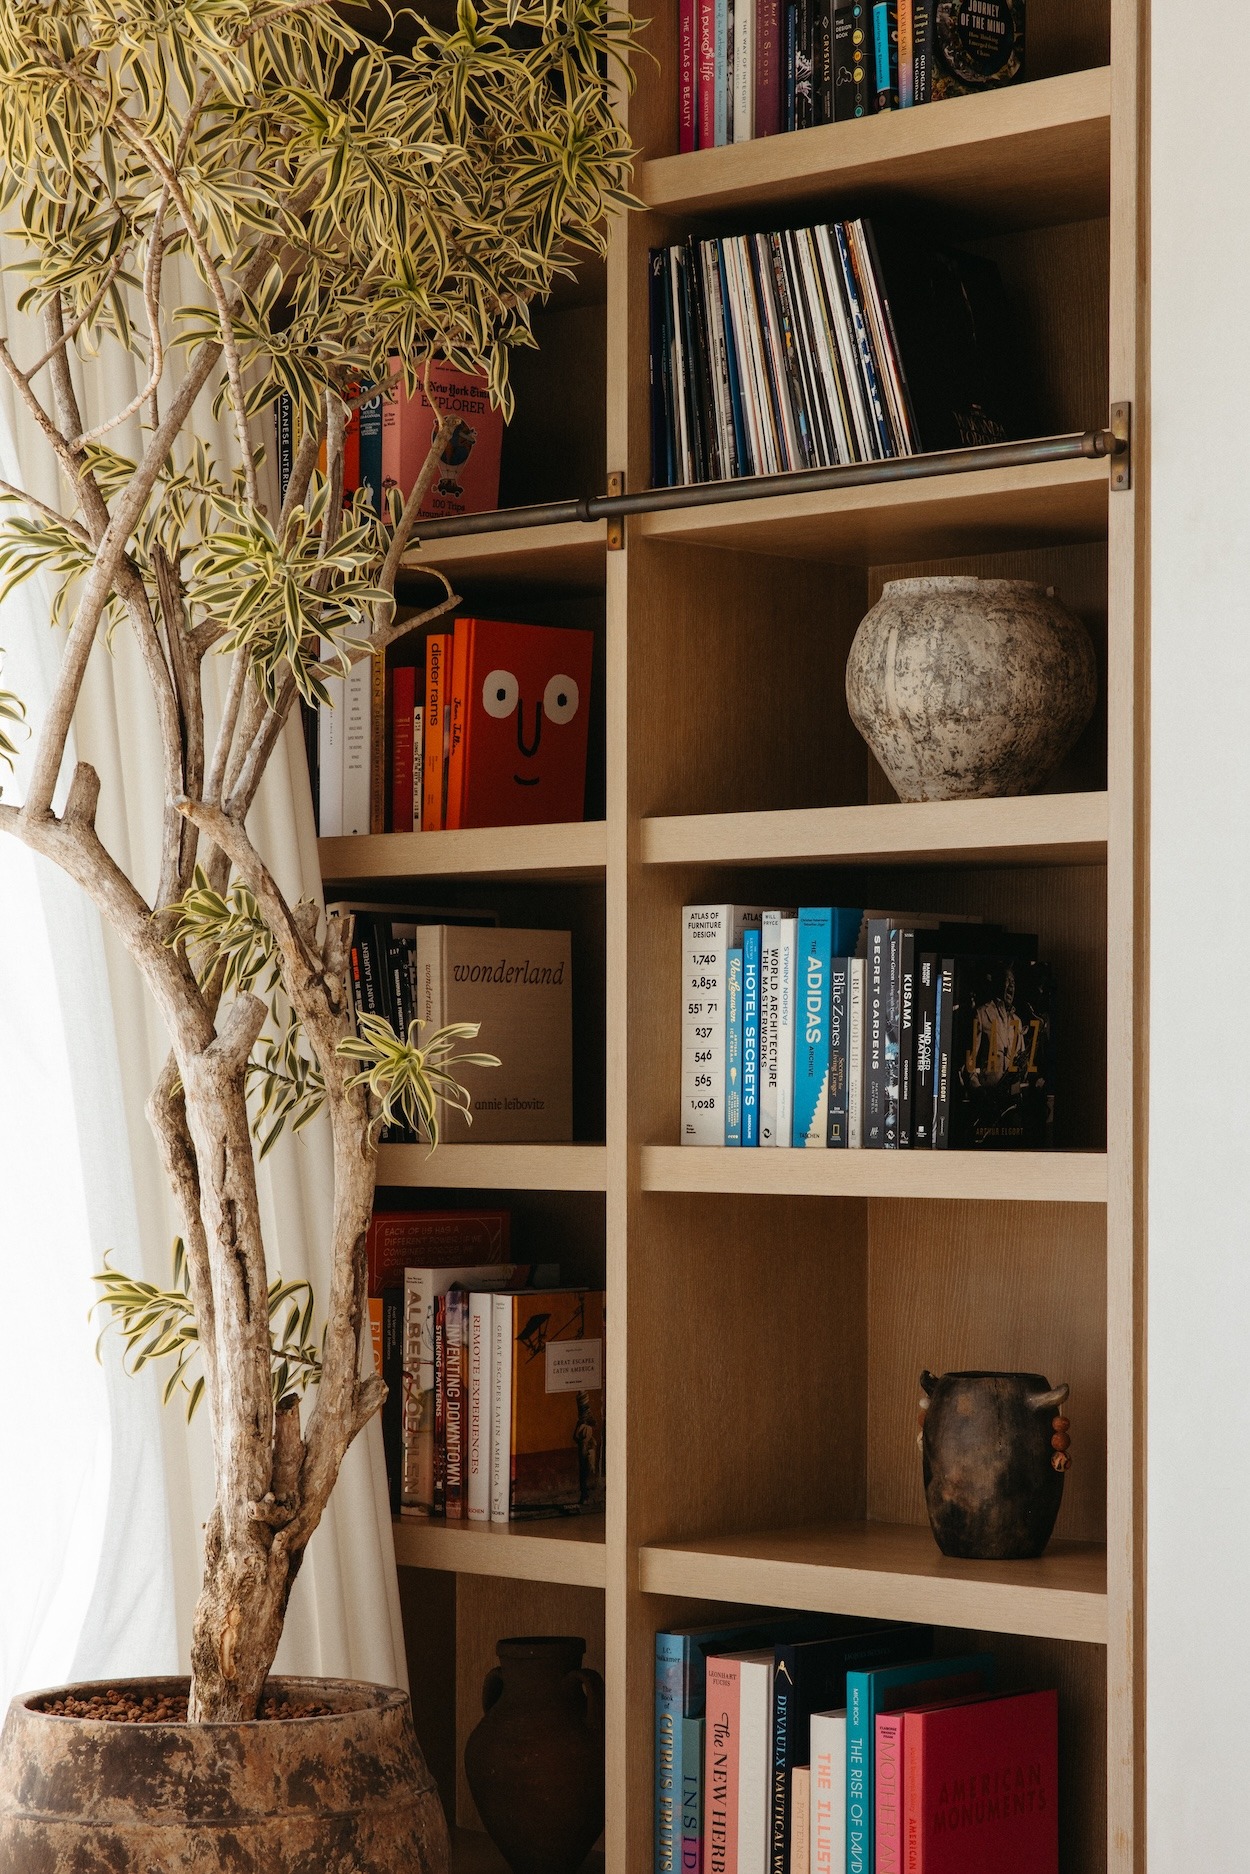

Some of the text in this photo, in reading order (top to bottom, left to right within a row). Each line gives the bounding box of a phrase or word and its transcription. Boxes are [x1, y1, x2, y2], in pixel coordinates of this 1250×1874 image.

[961, 13, 1005, 35] OF THE MIND
[968, 0, 999, 18] JOURNEY
[700, 5, 713, 81] A pukka life
[683, 71, 690, 82] OF
[742, 58, 747, 68] OF
[763, 41, 771, 86] STONE
[449, 384, 469, 397] York
[432, 499, 465, 512] 100 Trips
[430, 643, 441, 726] dieter rams
[451, 697, 461, 756] Jean Jullien
[688, 922, 721, 930] FURNITURE
[693, 931, 716, 939] DESIGN
[361, 941, 376, 1009] SAINT LAURENT
[454, 960, 565, 985] wonderland
[692, 954, 717, 965] 1,740
[425, 964, 434, 1022] wonderland
[691, 978, 717, 989] 2,852
[805, 955, 822, 1043] ADIDAS
[942, 971, 951, 993] JAZZ
[688, 1003, 717, 1014] 551 71
[769, 948, 778, 1088] WORLD ARCHITECTURE
[831, 971, 844, 1046] Blue Zones
[872, 935, 881, 1069] SECRET GARDENS
[902, 974, 912, 1029] KUSAMA
[695, 1028, 713, 1038] 237
[744, 964, 755, 1106] HOTEL SECRETS
[851, 1010, 859, 1040] GOOD
[694, 1050, 712, 1062] 546
[830, 1050, 838, 1071] Living
[923, 1046, 931, 1071] OVER
[965, 1019, 1041, 1072] JAZZ
[694, 1074, 712, 1086] 565
[830, 1073, 838, 1097] Longer
[475, 1098, 545, 1110] annie leibovitz
[691, 1098, 715, 1109] 1,028
[976, 1127, 999, 1136] ARTHUR
[384, 1226, 450, 1236] EACH OF US HAS
[384, 1237, 426, 1246] DIFFERENT
[405, 1289, 422, 1387] ALBERT
[446, 1324, 461, 1486] INVENTING DOWNTOWN
[471, 1314, 480, 1475] REMOTE EXPERIENCES
[404, 1400, 422, 1495] OEHLEN
[708, 1671, 737, 1680] LEONHART
[712, 1679, 731, 1687] FUCHS
[774, 1694, 787, 1851] DEVAULX NAUTICAL
[939, 1763, 1041, 1807] AMERICAN
[659, 1713, 674, 1872] CITRUS FRUITS
[710, 1712, 730, 1874] The NEW HERB
[850, 1738, 862, 1874] THE RISE OF DAVID
[879, 1741, 896, 1874] MOTHER AN
[683, 1775, 698, 1870] INSID
[817, 1753, 831, 1874] THE ILLUST
[933, 1788, 1046, 1835] MONUMENTS
[909, 1818, 917, 1870] AMERICAN
